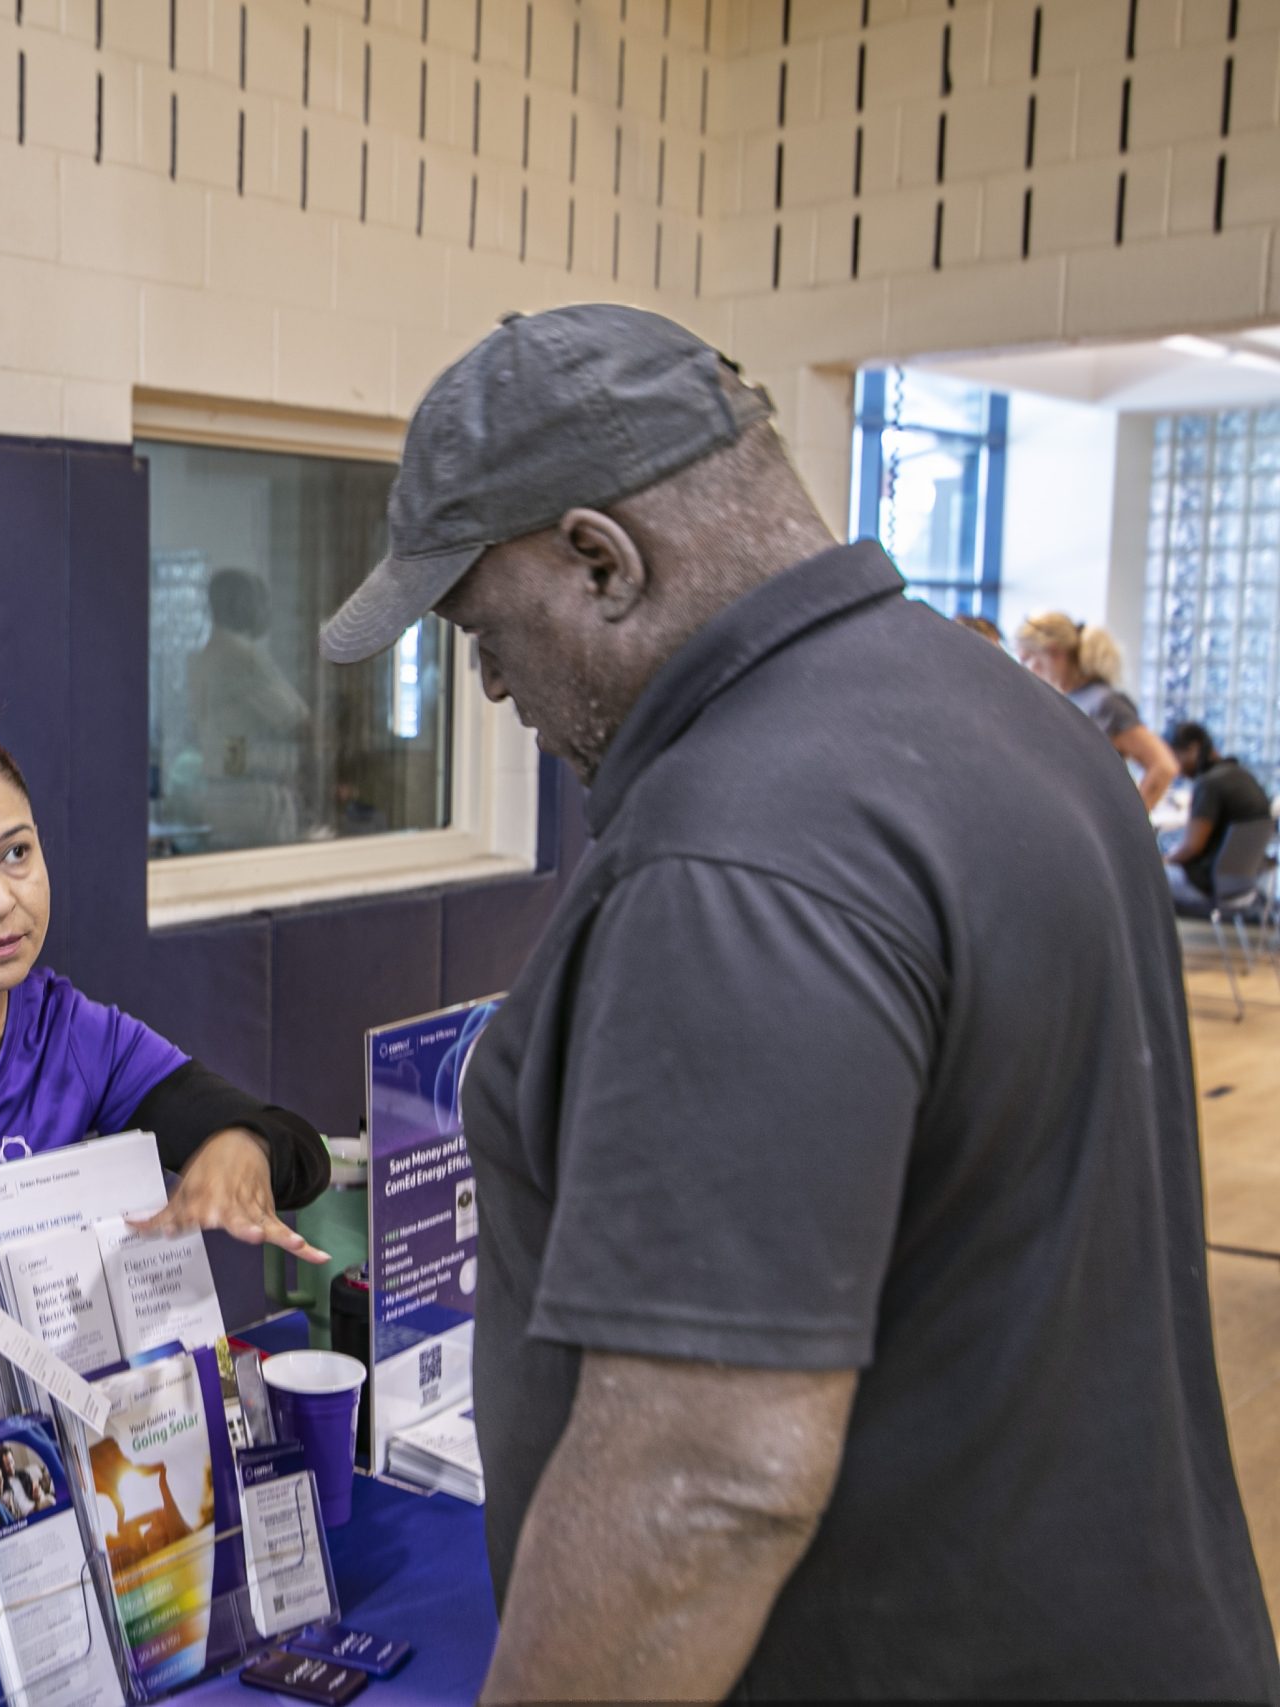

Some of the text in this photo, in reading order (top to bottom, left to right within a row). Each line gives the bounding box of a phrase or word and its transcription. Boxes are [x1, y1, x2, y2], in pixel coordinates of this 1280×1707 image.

[389, 1157, 411, 1176] Save
[411, 1145, 441, 1168] Money
[442, 1136, 458, 1157] and
[384, 1171, 416, 1197] ComEd
[417, 1162, 447, 1186] Energy
[36, 1219, 49, 1232] NET
[400, 1223, 417, 1239] Home
[417, 1209, 452, 1231] Assessments
[123, 1246, 192, 1273] Electric Vehicle
[385, 1242, 408, 1260] Rebates
[128, 1264, 183, 1289] Charger and
[385, 1255, 413, 1276] Discounts
[400, 1268, 420, 1286] Energy
[420, 1260, 441, 1277] Savings
[441, 1249, 465, 1267] Products
[32, 1272, 79, 1297] Business and
[131, 1280, 181, 1303] Installation
[395, 1284, 418, 1302] Account
[418, 1276, 437, 1293] Online
[437, 1270, 451, 1285] Tools
[35, 1288, 82, 1311] Public Sector
[135, 1300, 171, 1319] Rebates
[38, 1299, 93, 1327] Electric Vehicle
[385, 1307, 397, 1323] And
[42, 1322, 77, 1341] Programs
[128, 1408, 177, 1435] Your Guide to
[131, 1412, 200, 1452] Going Solar
